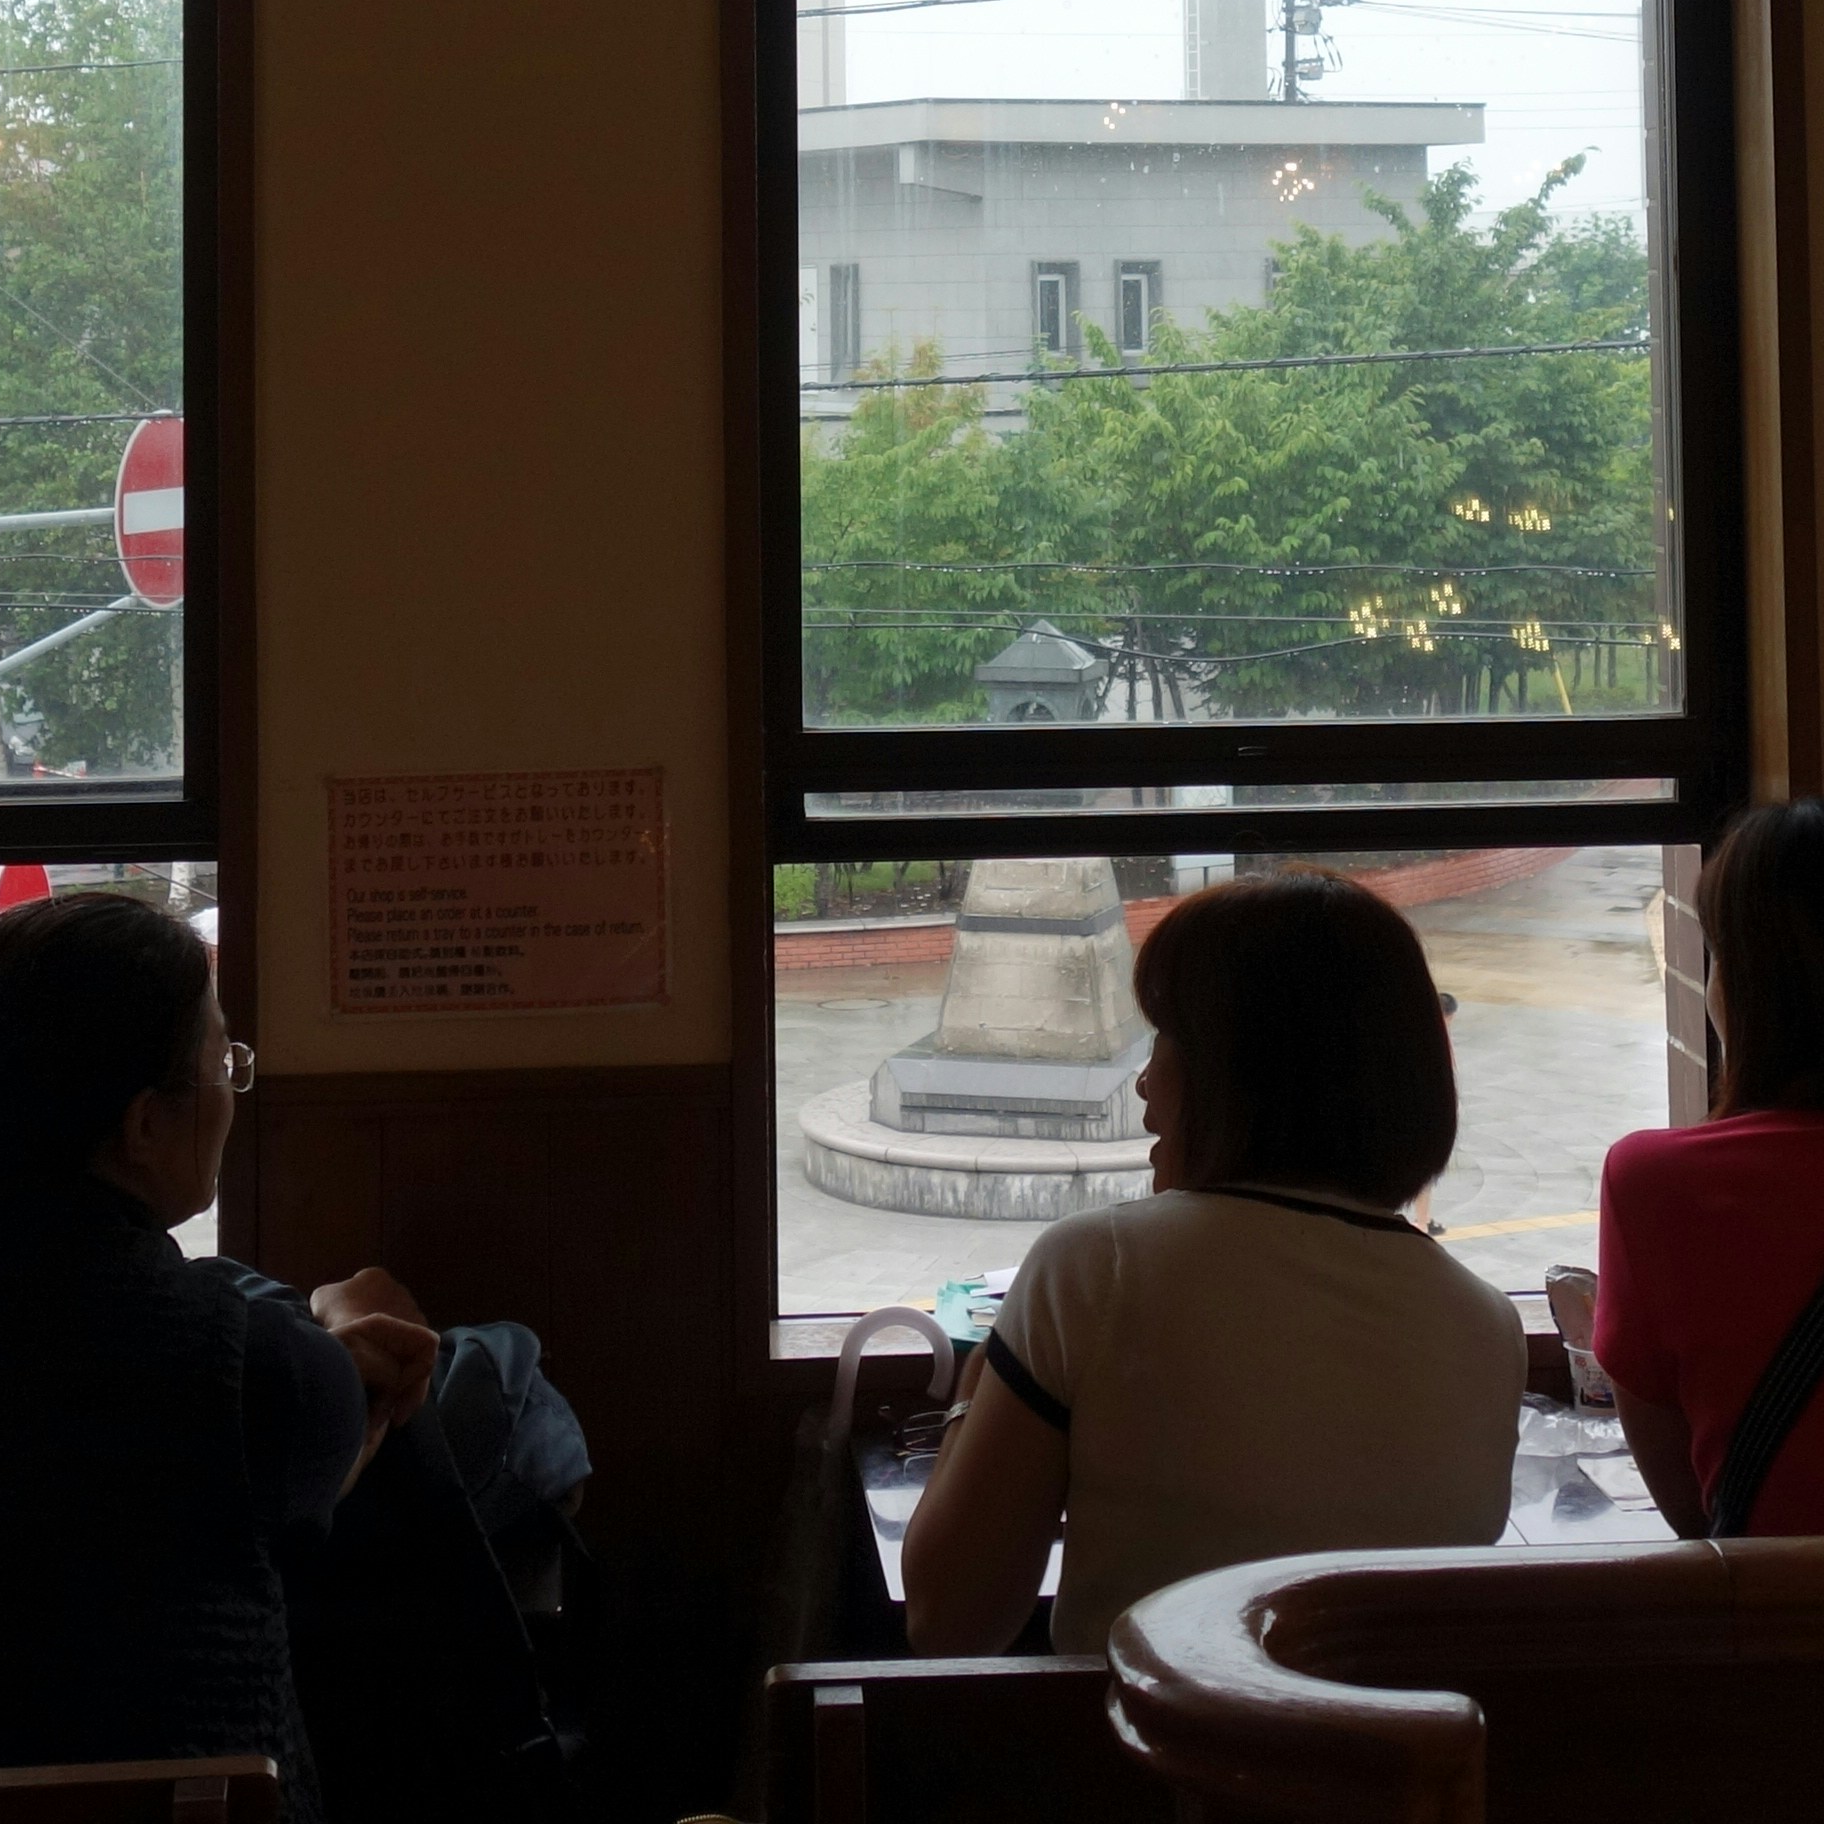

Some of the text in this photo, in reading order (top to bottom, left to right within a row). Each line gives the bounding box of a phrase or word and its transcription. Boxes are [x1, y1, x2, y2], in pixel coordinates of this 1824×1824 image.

[346, 887, 365, 904] Our
[369, 888, 394, 904] shop
[347, 907, 383, 923] Please
[386, 907, 416, 924] place
[420, 909, 433, 921] an
[436, 906, 464, 920] order
[470, 906, 482, 920] at
[347, 927, 383, 943] Please
[386, 928, 419, 942] return
[433, 927, 455, 944] tray
[458, 925, 471, 940] to
[484, 925, 527, 940] counter
[530, 924, 540, 938] in
[543, 922, 562, 937] the
[564, 923, 591, 938] case
[594, 920, 606, 936] of
